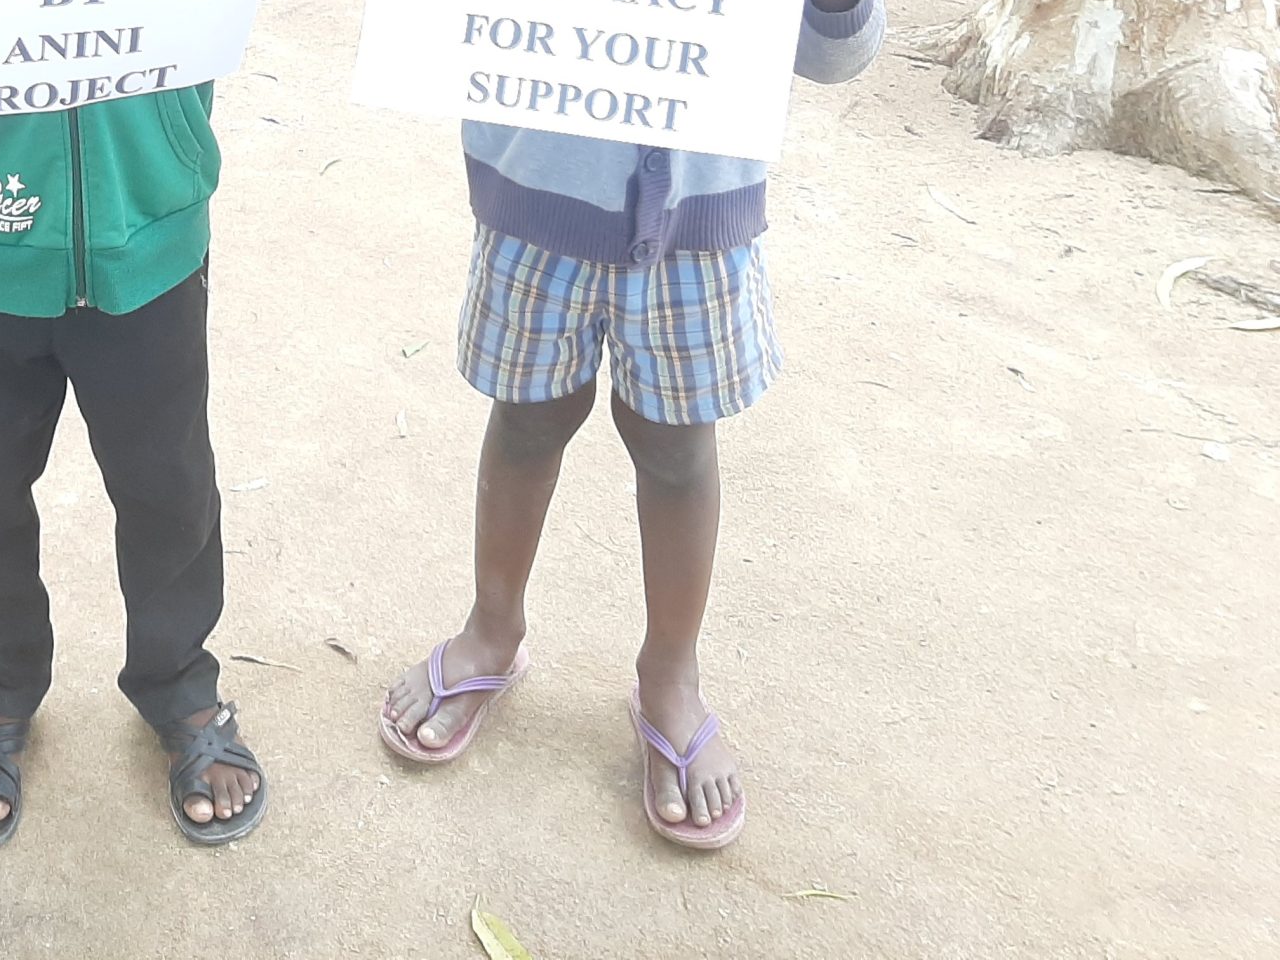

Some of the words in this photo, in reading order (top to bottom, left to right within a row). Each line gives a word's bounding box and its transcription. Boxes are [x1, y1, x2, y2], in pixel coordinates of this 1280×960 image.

[2, 26, 145, 65] ANINI
[461, 13, 557, 57] FOR
[572, 26, 710, 77] YOUR
[466, 71, 688, 132] SUPPORT
